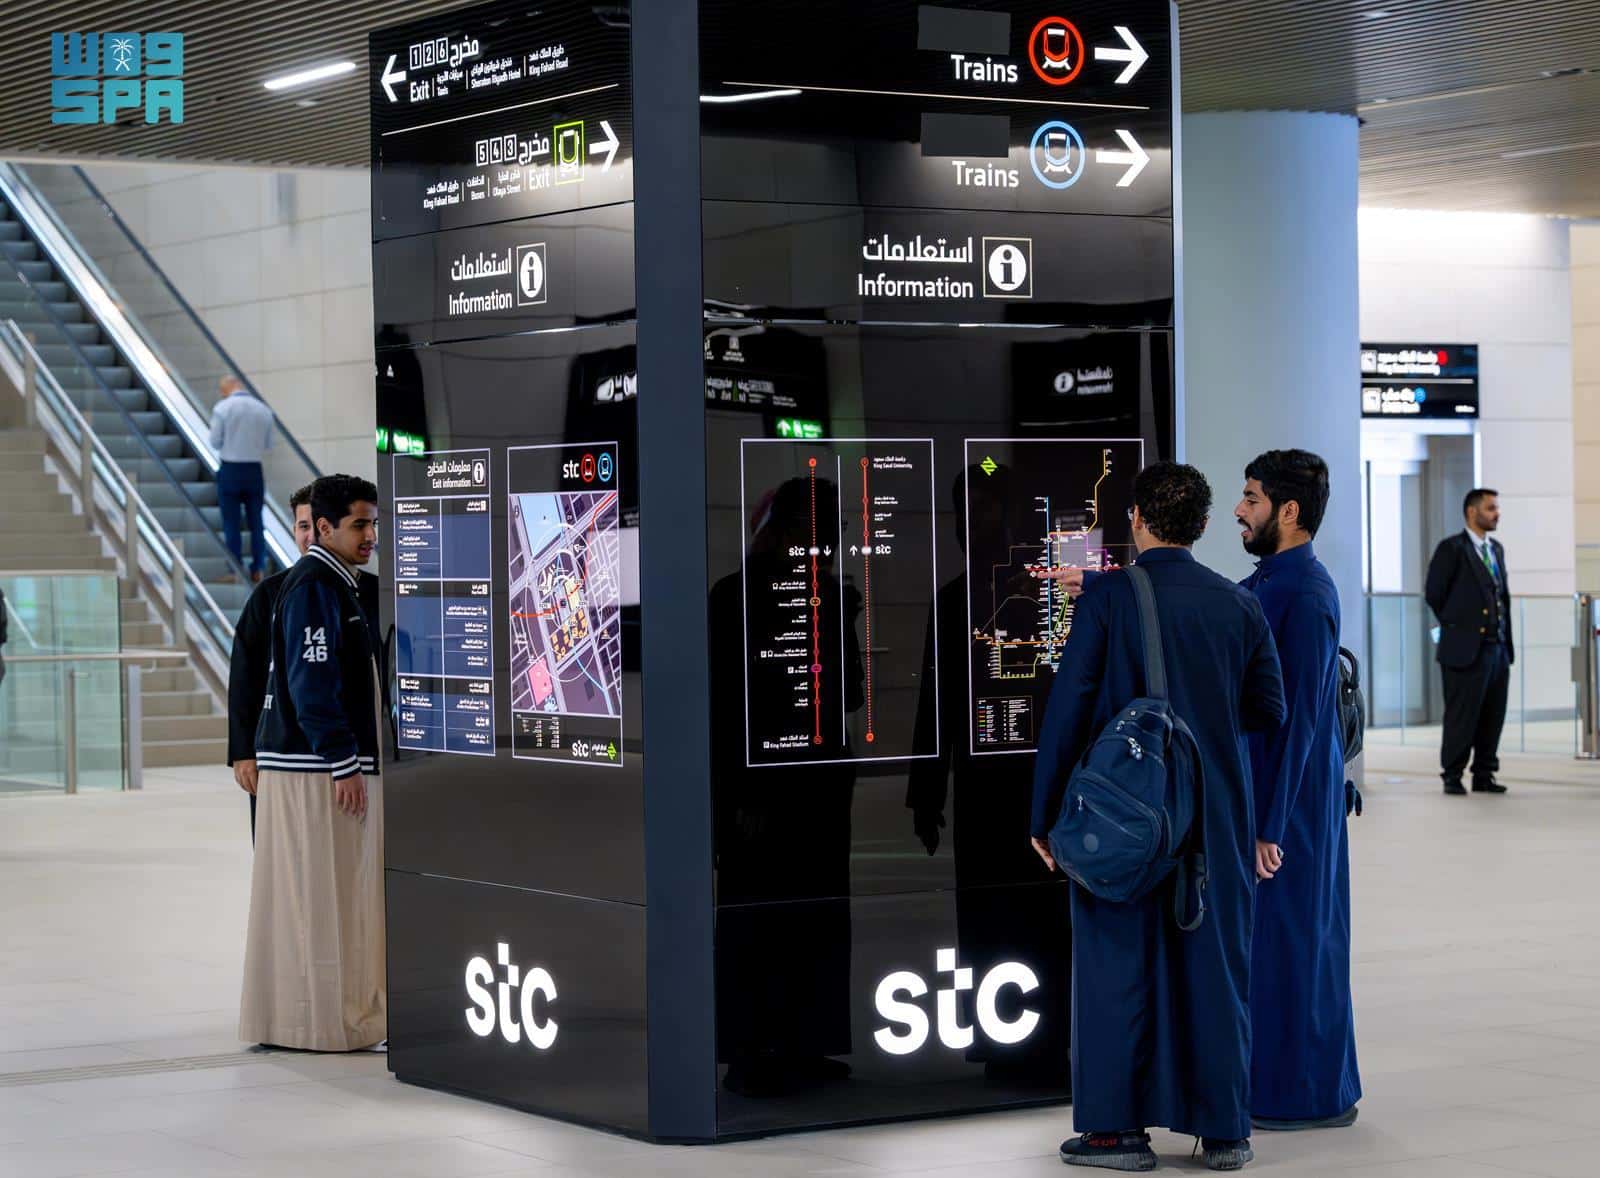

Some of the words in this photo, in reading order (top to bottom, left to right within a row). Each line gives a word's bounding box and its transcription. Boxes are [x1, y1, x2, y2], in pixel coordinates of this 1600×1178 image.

[450, 35, 479, 68] مخرج
[950, 54, 1018, 83] Trains
[410, 80, 430, 103] Exit
[518, 133, 550, 165] مخرج
[529, 168, 550, 190] Exit
[952, 160, 1019, 188] Trains
[863, 234, 973, 263] استعلامات
[451, 248, 512, 281] استعلامات
[858, 273, 974, 298] Information
[449, 289, 513, 315] Information
[563, 460, 580, 479] stc
[432, 478, 442, 488] Exit
[788, 545, 806, 556] stc
[875, 544, 892, 555] stc
[304, 626, 327, 645] 14
[302, 646, 328, 662] 46
[571, 739, 589, 757] stc
[464, 942, 559, 1050] stc
[873, 947, 1041, 1055] stc
